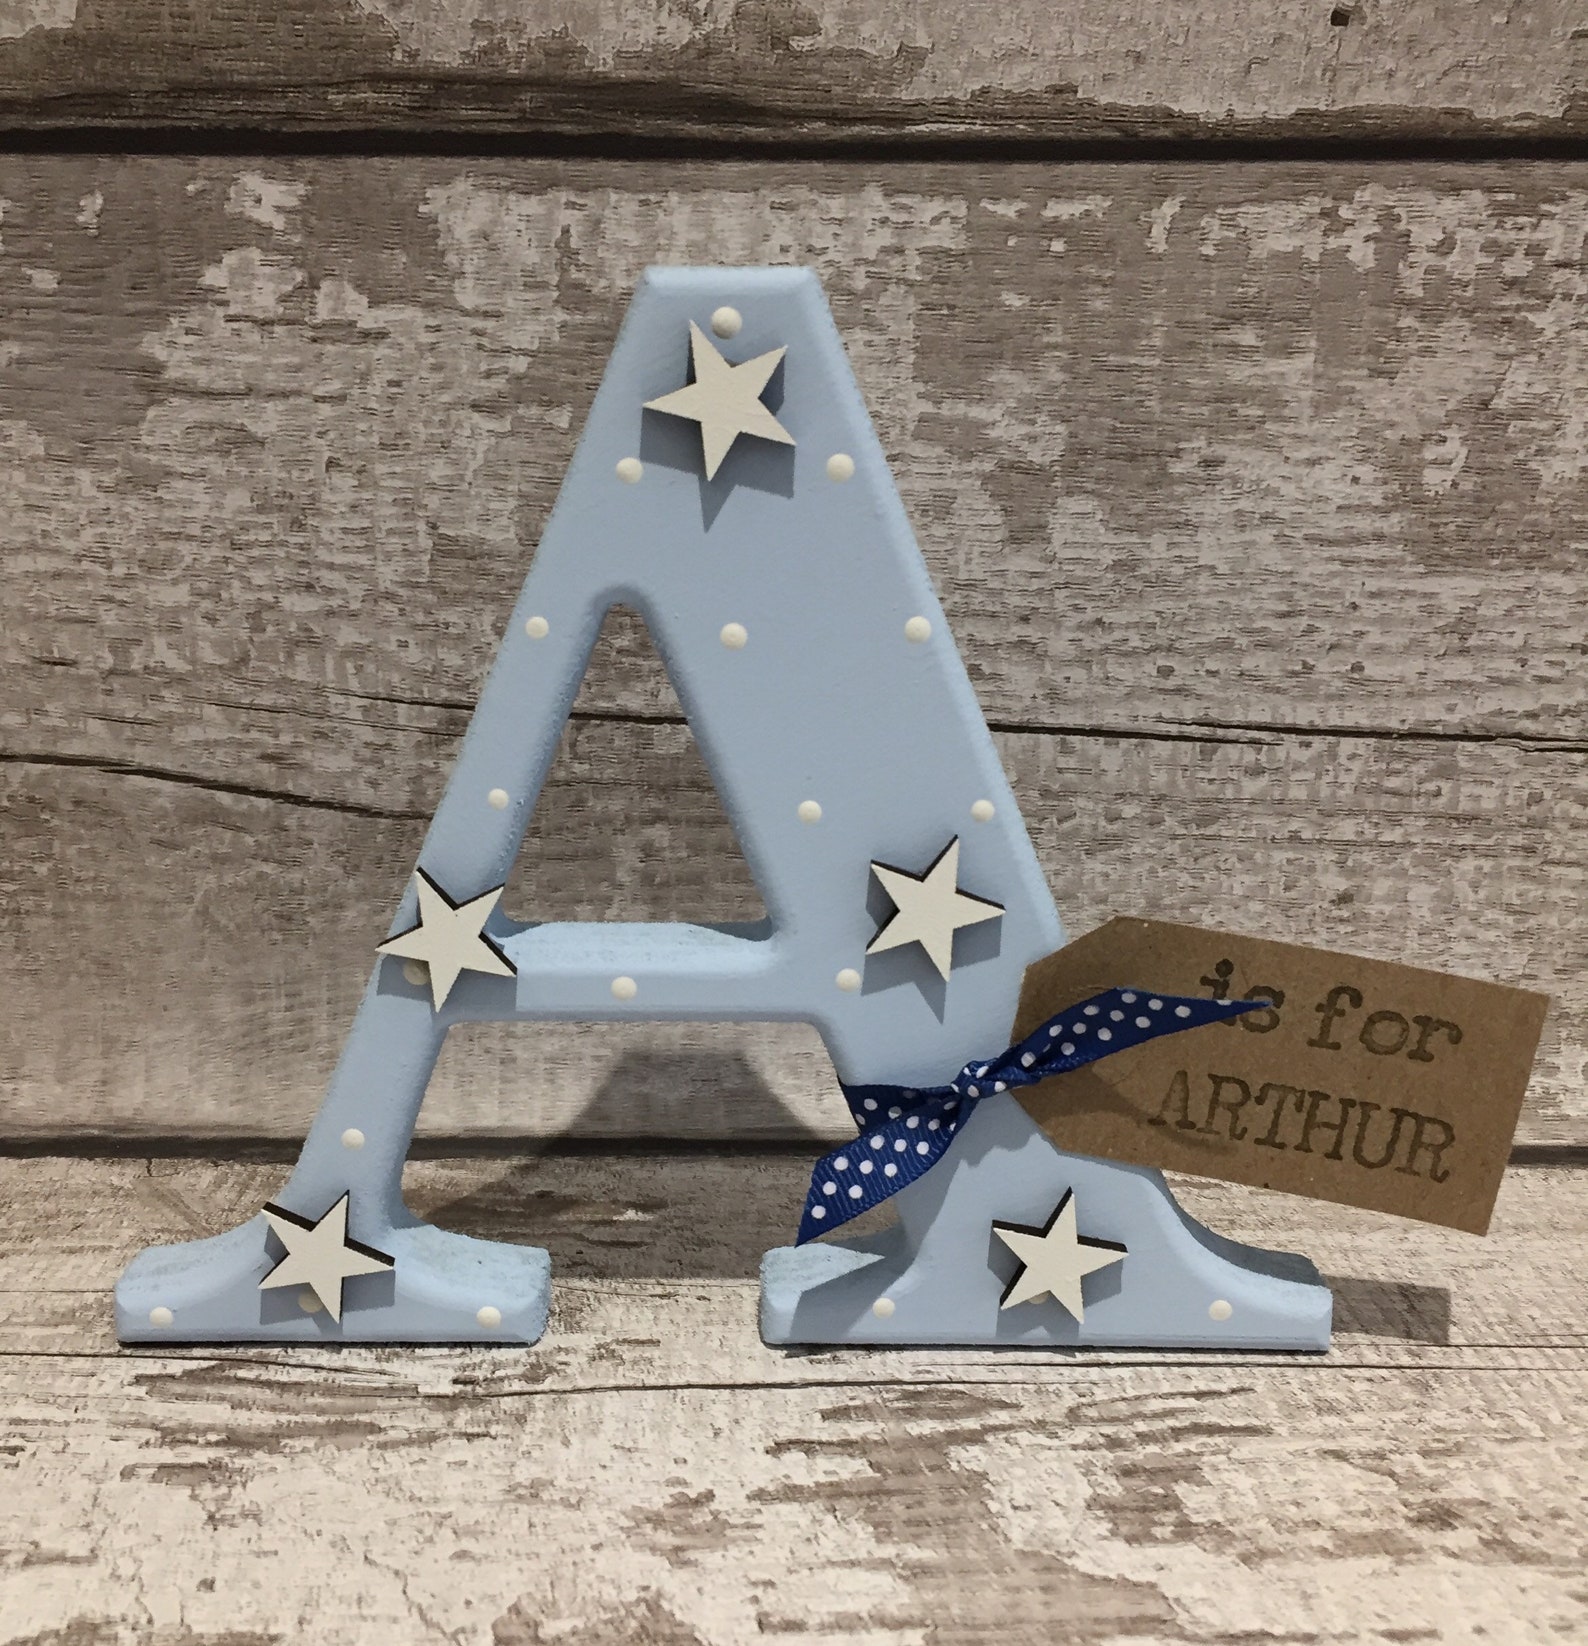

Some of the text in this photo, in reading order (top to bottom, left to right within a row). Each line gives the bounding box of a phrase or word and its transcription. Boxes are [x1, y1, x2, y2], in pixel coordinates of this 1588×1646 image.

[115, 265, 1333, 1352] A
[1199, 958, 1464, 1063] is for
[1146, 1069, 1456, 1184] ARTHUR
